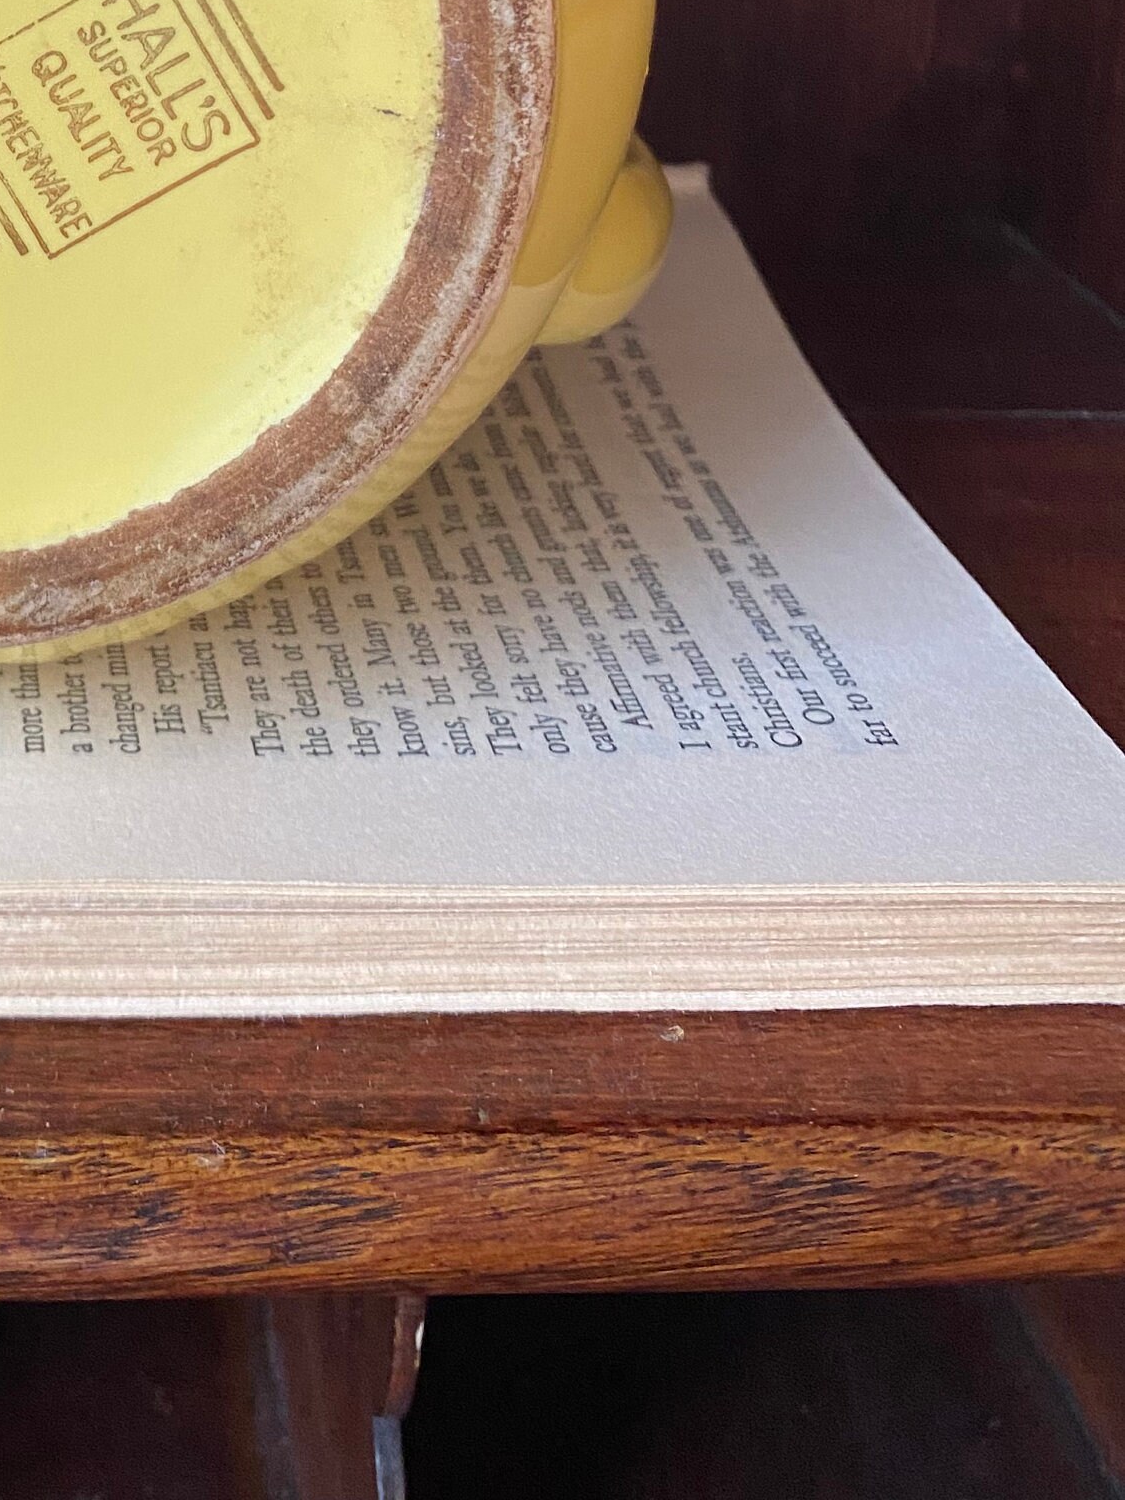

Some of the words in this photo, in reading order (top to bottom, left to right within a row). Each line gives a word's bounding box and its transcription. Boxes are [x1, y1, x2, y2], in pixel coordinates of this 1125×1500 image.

[77, 20, 177, 166] SUPERIOR
[31, 50, 134, 181] QUALITY
[359, 618, 397, 667] Many
[406, 623, 439, 666] those
[449, 618, 470, 635] at
[494, 625, 528, 664] sorry
[536, 615, 572, 652] have
[622, 628, 658, 666] with
[145, 645, 181, 694] report
[234, 638, 261, 666] not
[275, 642, 303, 661] of
[452, 642, 498, 698] looked
[773, 650, 811, 680] first
[791, 624, 857, 687] succeed
[11, 663, 44, 699] than
[247, 676, 270, 702] are
[283, 670, 320, 718] death
[320, 643, 364, 708] ordered
[380, 677, 409, 696] it.
[428, 676, 456, 706] but
[513, 674, 547, 703] felt
[554, 658, 595, 696] they
[590, 632, 653, 730] Affirmative
[55, 672, 90, 734] brother
[103, 683, 144, 753] changed
[155, 703, 186, 734] His
[649, 673, 705, 731] agreed
[728, 652, 803, 748] Christians.
[795, 688, 836, 725] Our
[845, 693, 874, 711] to
[19, 707, 45, 752] more
[252, 710, 285, 757] They
[303, 727, 333, 757] the
[350, 716, 381, 757] they
[392, 706, 430, 757] know
[445, 715, 477, 756] sins,
[489, 706, 523, 756] They
[531, 713, 570, 755] only
[583, 703, 618, 753] cause
[680, 742, 712, 751] I
[712, 703, 759, 749] stant
[865, 720, 898, 747] far
[71, 743, 93, 752] a
